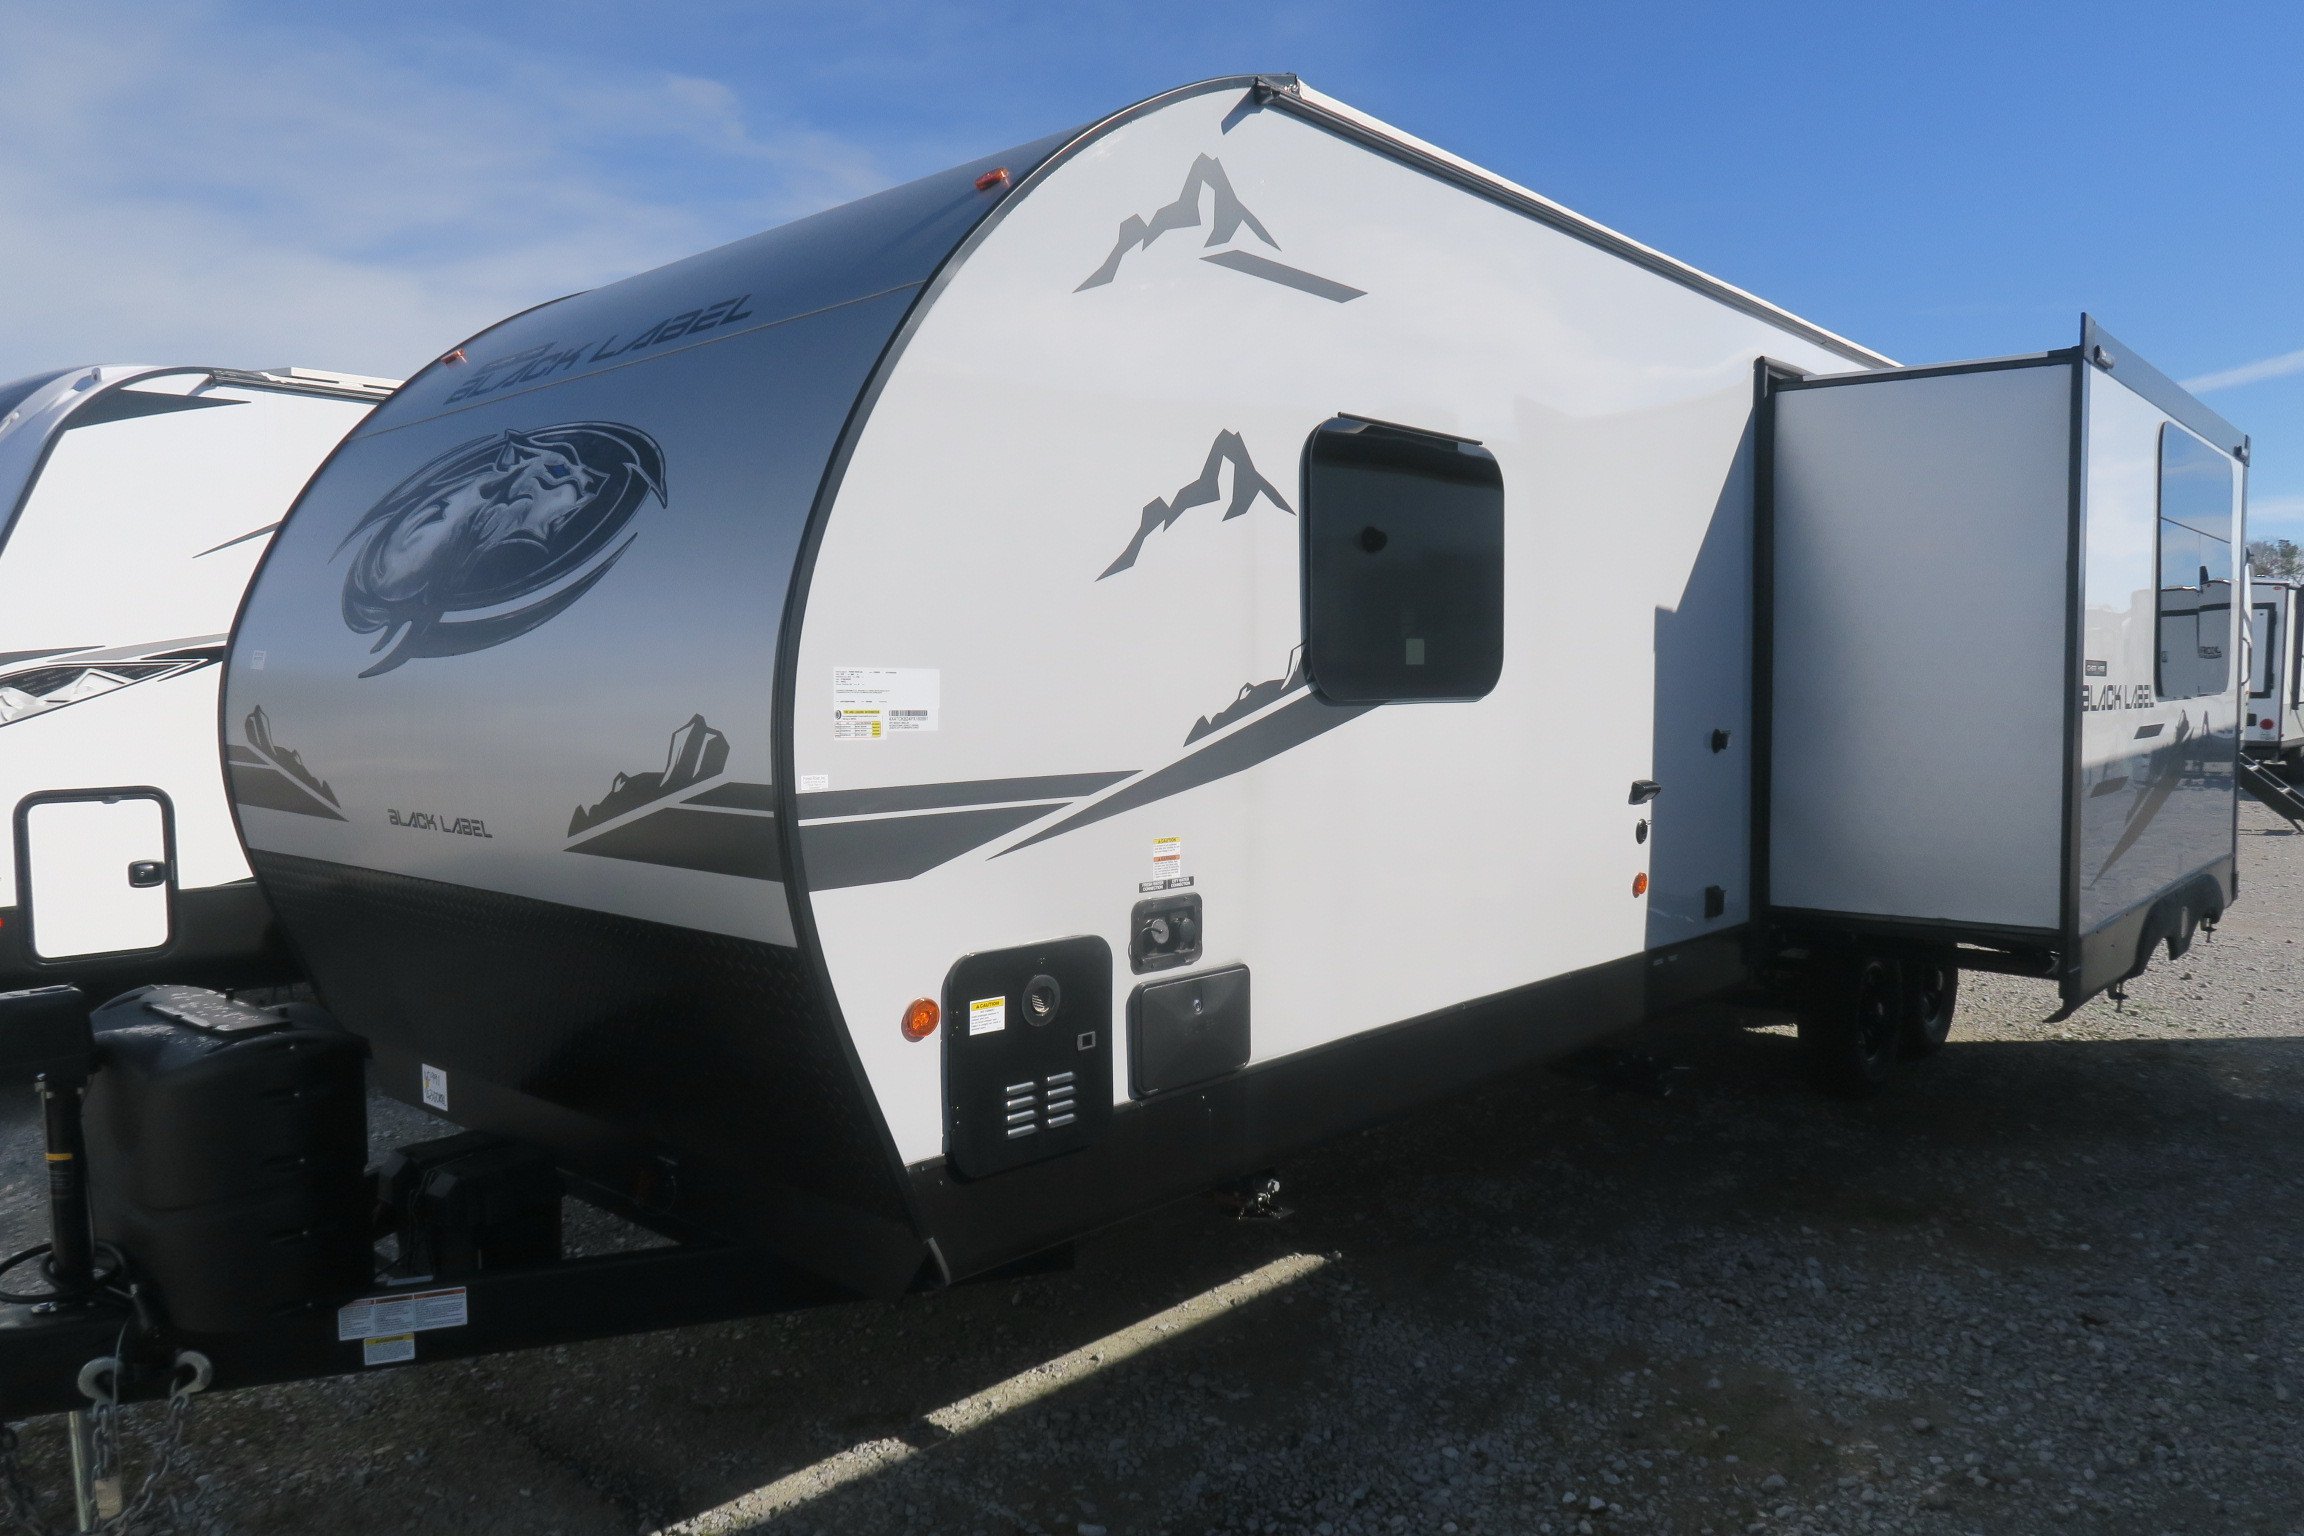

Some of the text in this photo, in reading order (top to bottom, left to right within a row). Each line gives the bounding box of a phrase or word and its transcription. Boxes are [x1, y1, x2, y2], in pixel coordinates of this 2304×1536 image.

[443, 343, 592, 406] BLACK
[588, 294, 753, 364] LABEL
[2081, 684, 2154, 710] BLACK LABEL
[387, 808, 493, 838] BLACK LABEL
